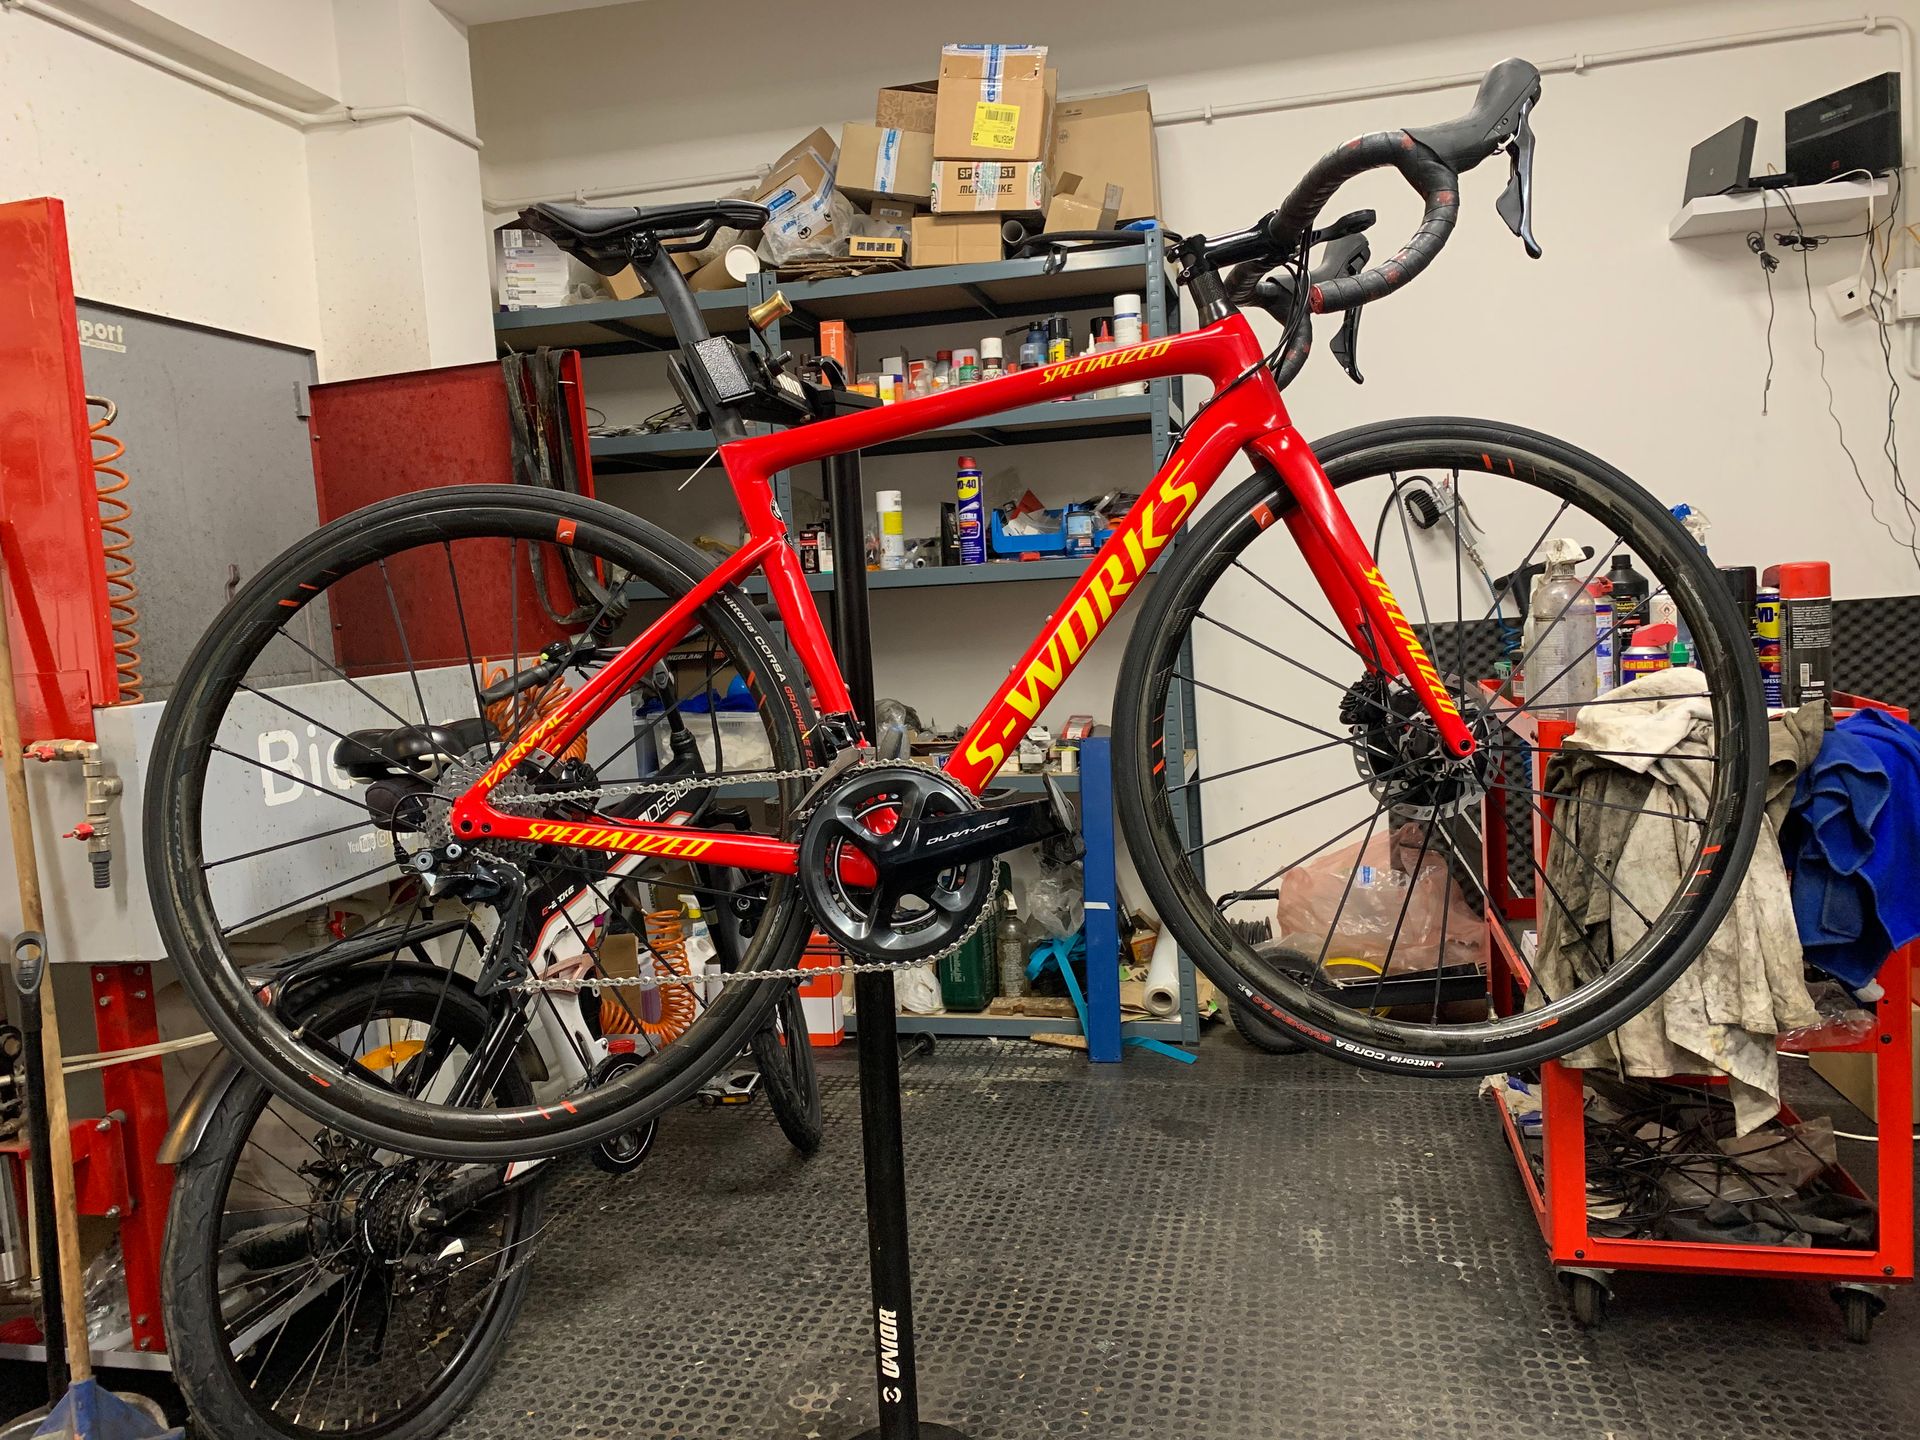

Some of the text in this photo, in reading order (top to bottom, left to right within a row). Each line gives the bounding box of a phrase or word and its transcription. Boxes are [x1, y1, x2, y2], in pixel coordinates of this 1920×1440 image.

[1040, 340, 1173, 385] SPECIALIZED
[965, 459, 1198, 788] S-WORKS
[1358, 562, 1460, 717] SPECIALIZED
[754, 636, 787, 683] CORSA
[478, 712, 569, 790] TARMAC
[518, 823, 715, 858] SPECIALIZED
[926, 817, 1010, 846] DURA-ACE
[1335, 1039, 1387, 1061] CORSA
[878, 1307, 901, 1379] UNIOR
